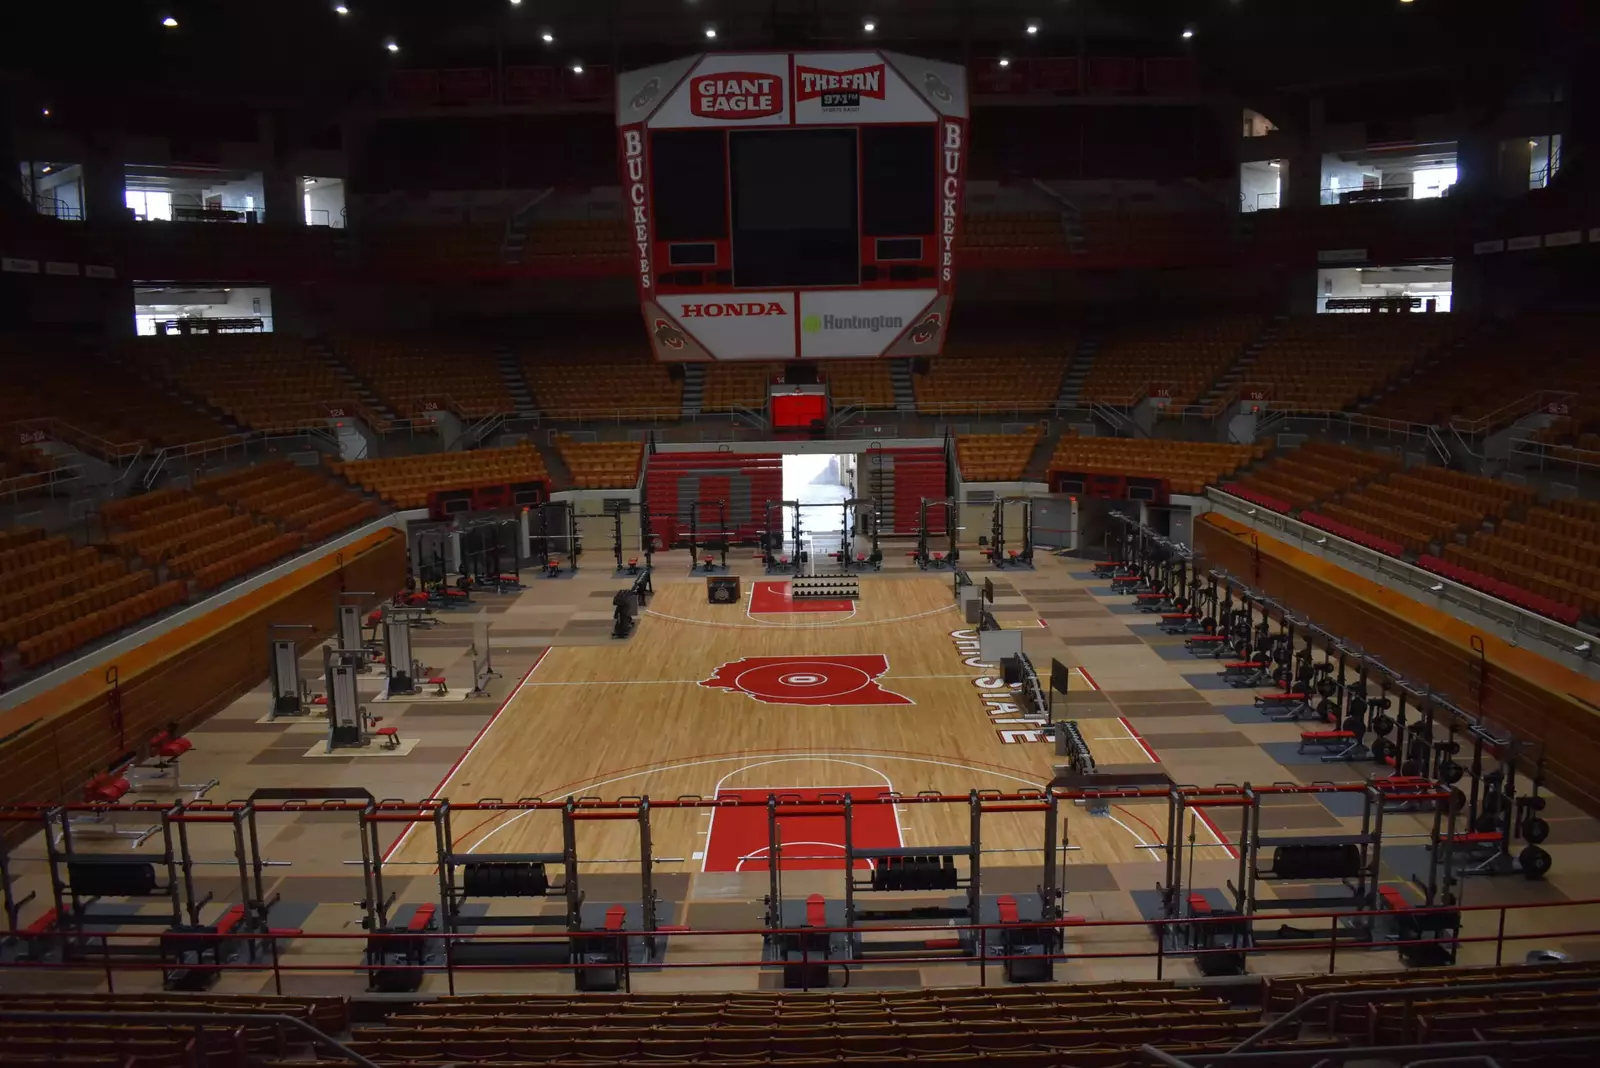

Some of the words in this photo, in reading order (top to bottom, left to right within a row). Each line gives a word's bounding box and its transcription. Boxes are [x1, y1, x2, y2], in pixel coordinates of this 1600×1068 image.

[698, 79, 774, 95] GIANT
[701, 96, 772, 111] EAGLE
[623, 130, 650, 289] BUCKEYES
[944, 122, 961, 281] BUCKEYES
[681, 302, 787, 318] HONDA
[823, 315, 903, 332] Huntington
